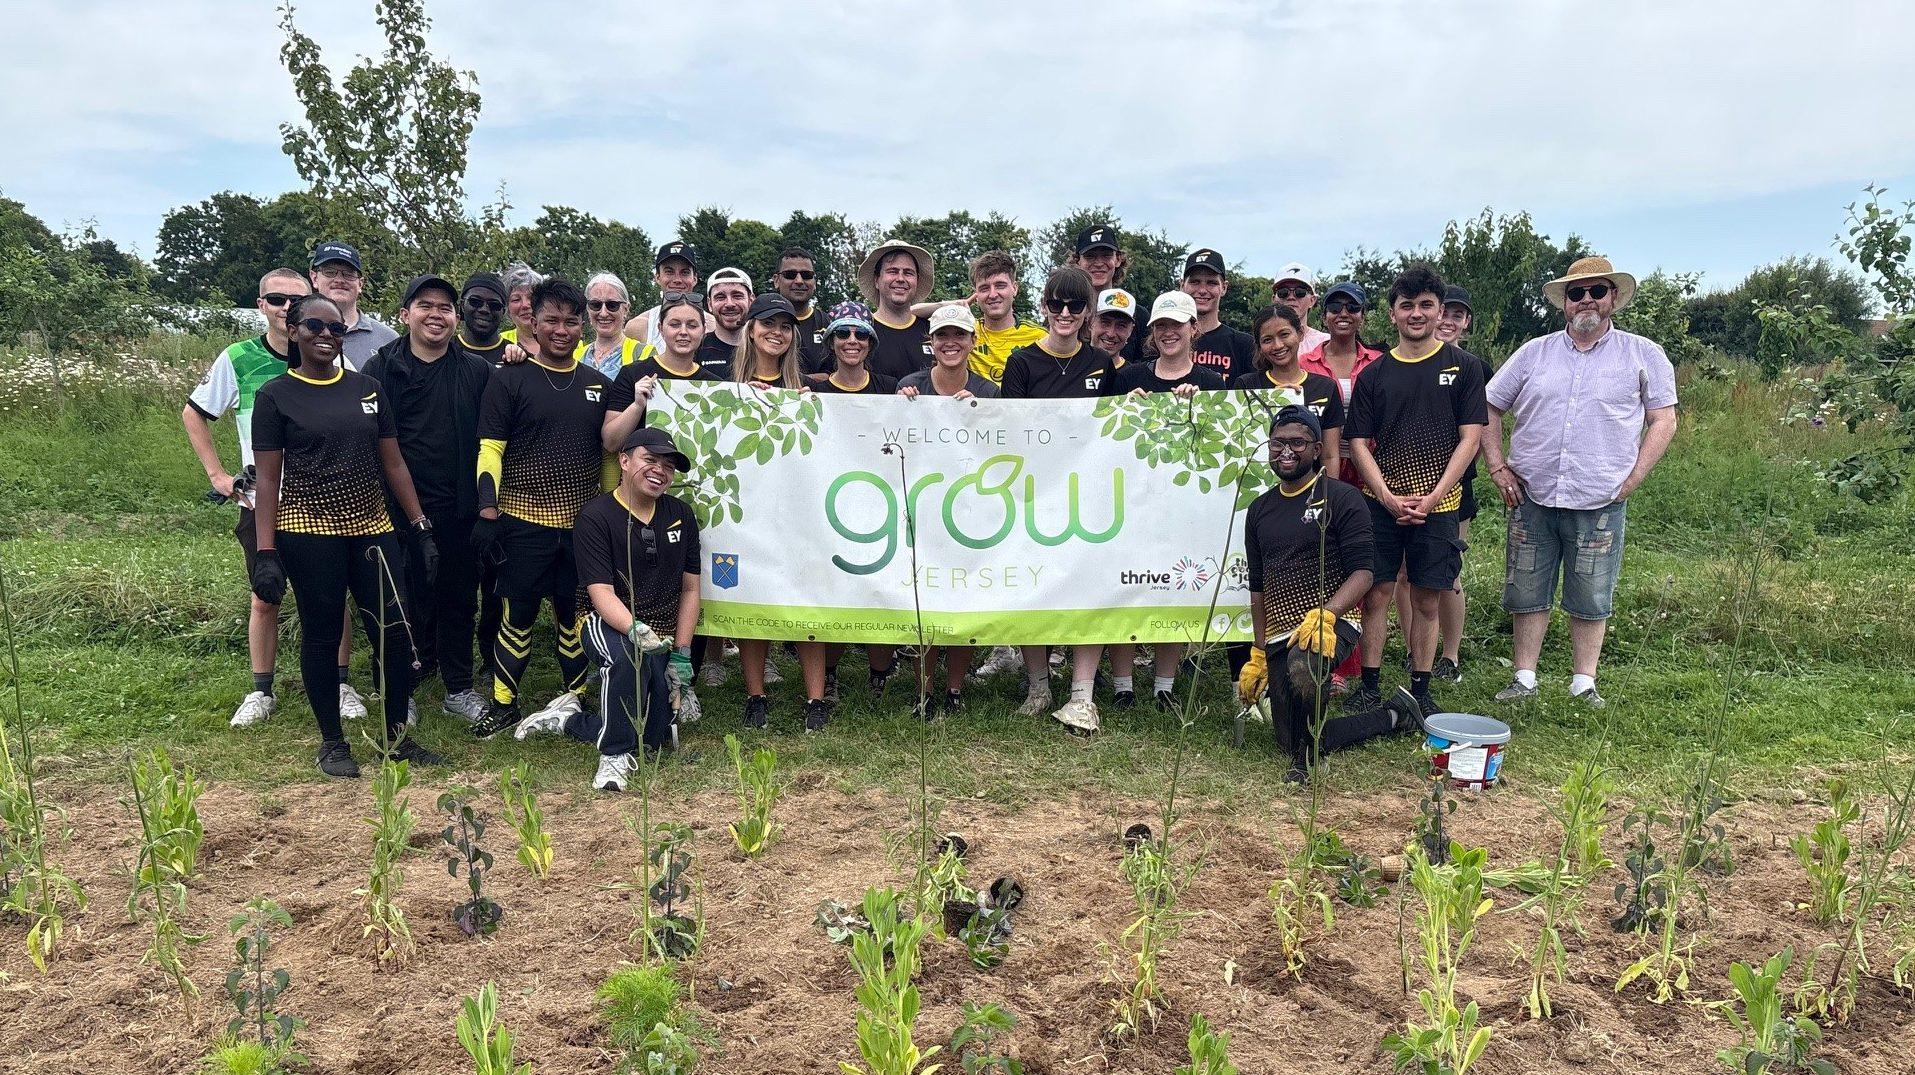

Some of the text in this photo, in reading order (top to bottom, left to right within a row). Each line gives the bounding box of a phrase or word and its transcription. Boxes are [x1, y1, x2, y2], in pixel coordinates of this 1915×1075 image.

[1085, 378, 1101, 390] EY
[1439, 373, 1457, 386] EY
[584, 389, 601, 402] EY
[361, 400, 379, 414] EY
[883, 427, 1052, 446] WELCOME TO
[825, 455, 1125, 575] grow
[667, 529, 681, 543] EY
[901, 565, 1044, 589] JERSEY
[1120, 570, 1171, 585] thrive
[712, 615, 736, 625] SCAN
[736, 617, 755, 626] THE
[756, 618, 780, 628] CODE
[781, 619, 794, 629] TO
[795, 620, 831, 630] RECEIVE
[832, 621, 853, 630] OUR
[854, 622, 895, 631] REGULAR
[1187, 619, 1200, 628] US
